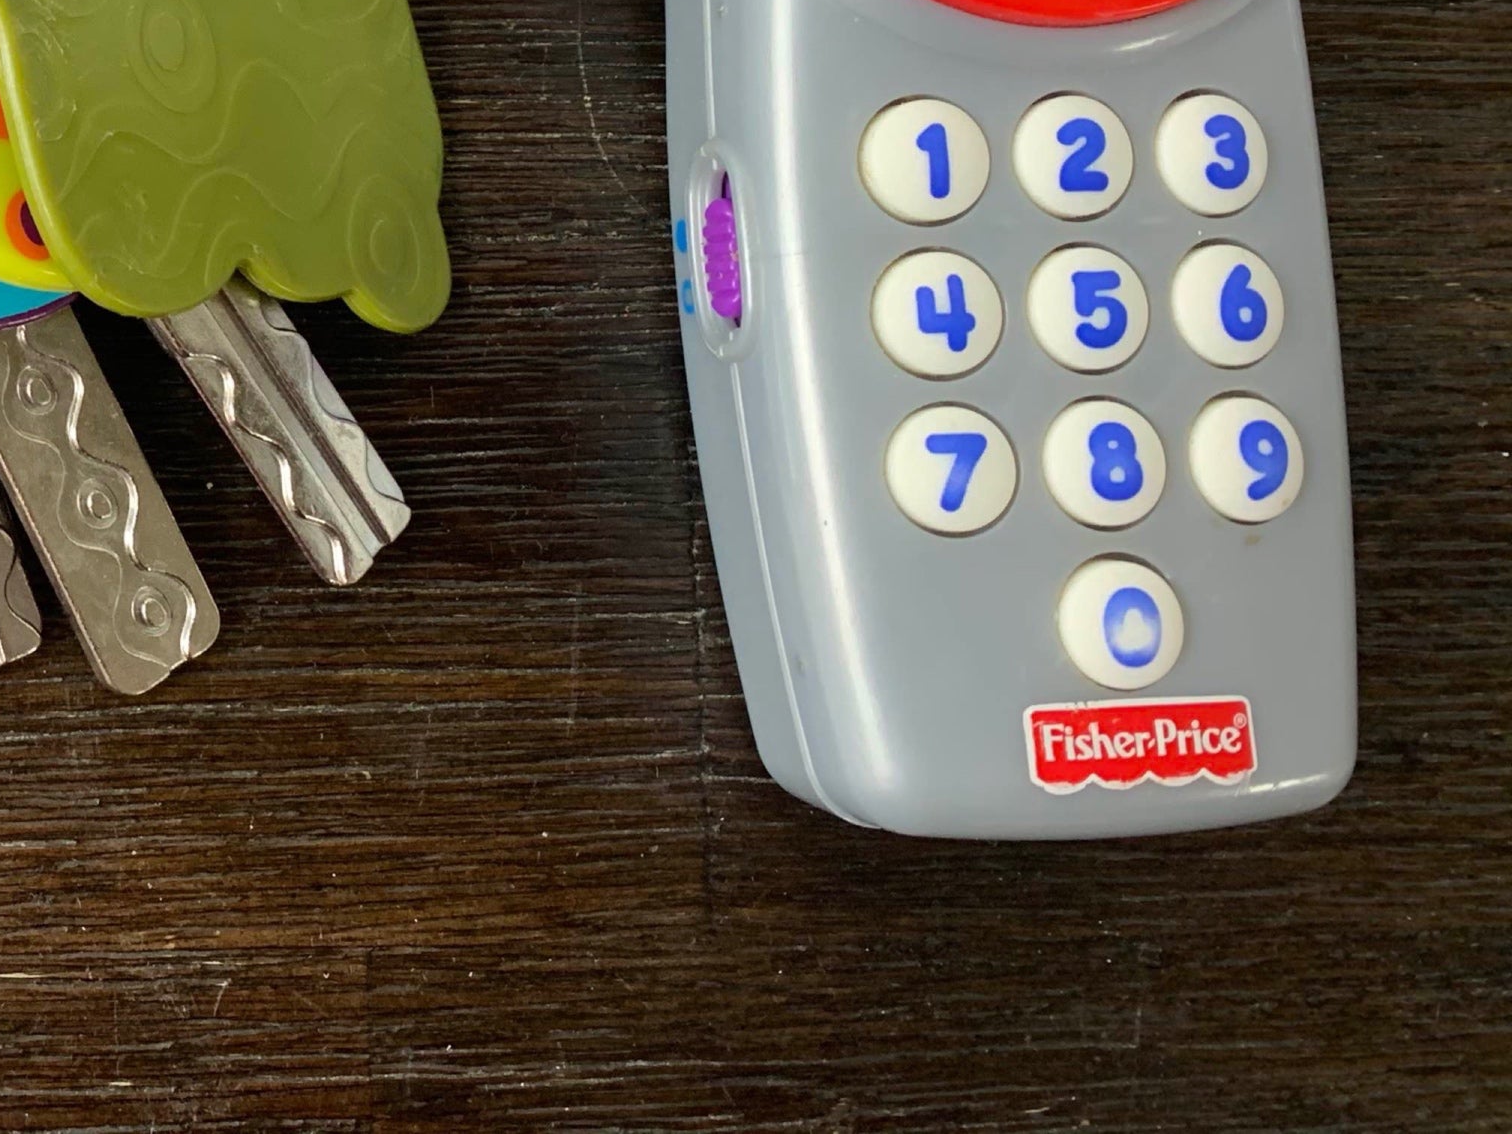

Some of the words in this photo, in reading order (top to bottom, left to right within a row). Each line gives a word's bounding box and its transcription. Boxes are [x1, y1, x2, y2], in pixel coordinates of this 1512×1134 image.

[914, 121, 952, 200] 1
[1054, 115, 1110, 194] 2
[1201, 112, 1251, 192] 3
[913, 272, 978, 354] 4
[1068, 268, 1130, 352] 5
[1216, 262, 1269, 344] 6
[923, 430, 989, 514] 7
[1085, 419, 1145, 504] 8
[1236, 418, 1290, 503] 9
[1101, 585, 1164, 670] 0
